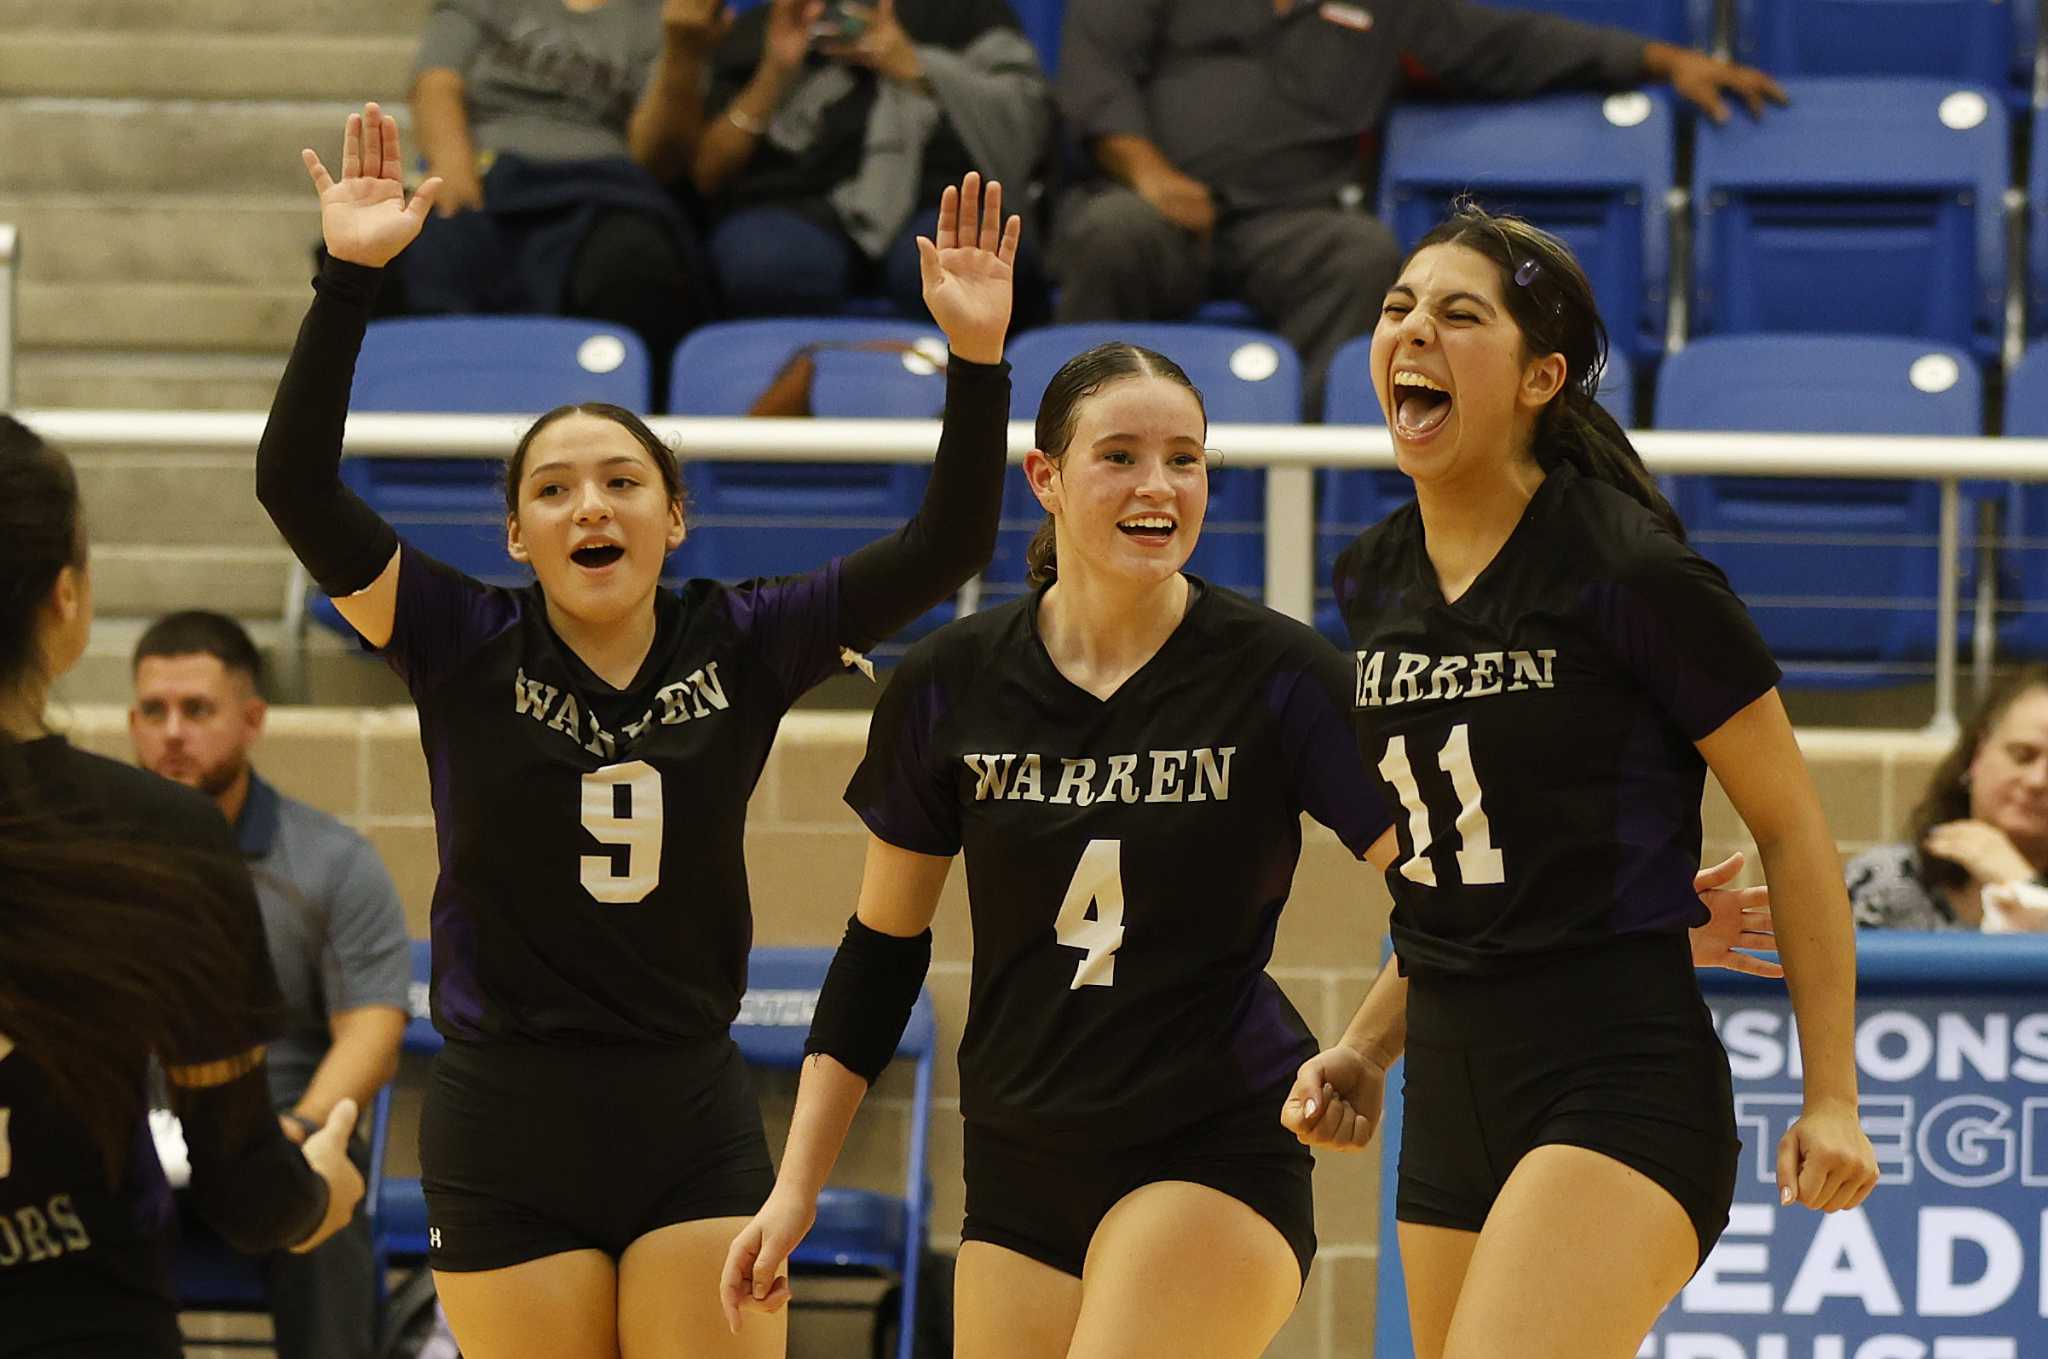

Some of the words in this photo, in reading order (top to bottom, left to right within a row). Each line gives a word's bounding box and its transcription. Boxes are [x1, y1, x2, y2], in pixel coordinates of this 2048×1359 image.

[1354, 649, 1558, 707] ARREN
[579, 759, 664, 903] 9
[963, 746, 1237, 807] WARREN
[1377, 723, 1506, 888] 11
[1053, 839, 1126, 990] 4
[1681, 1204, 2048, 1317] EAD
